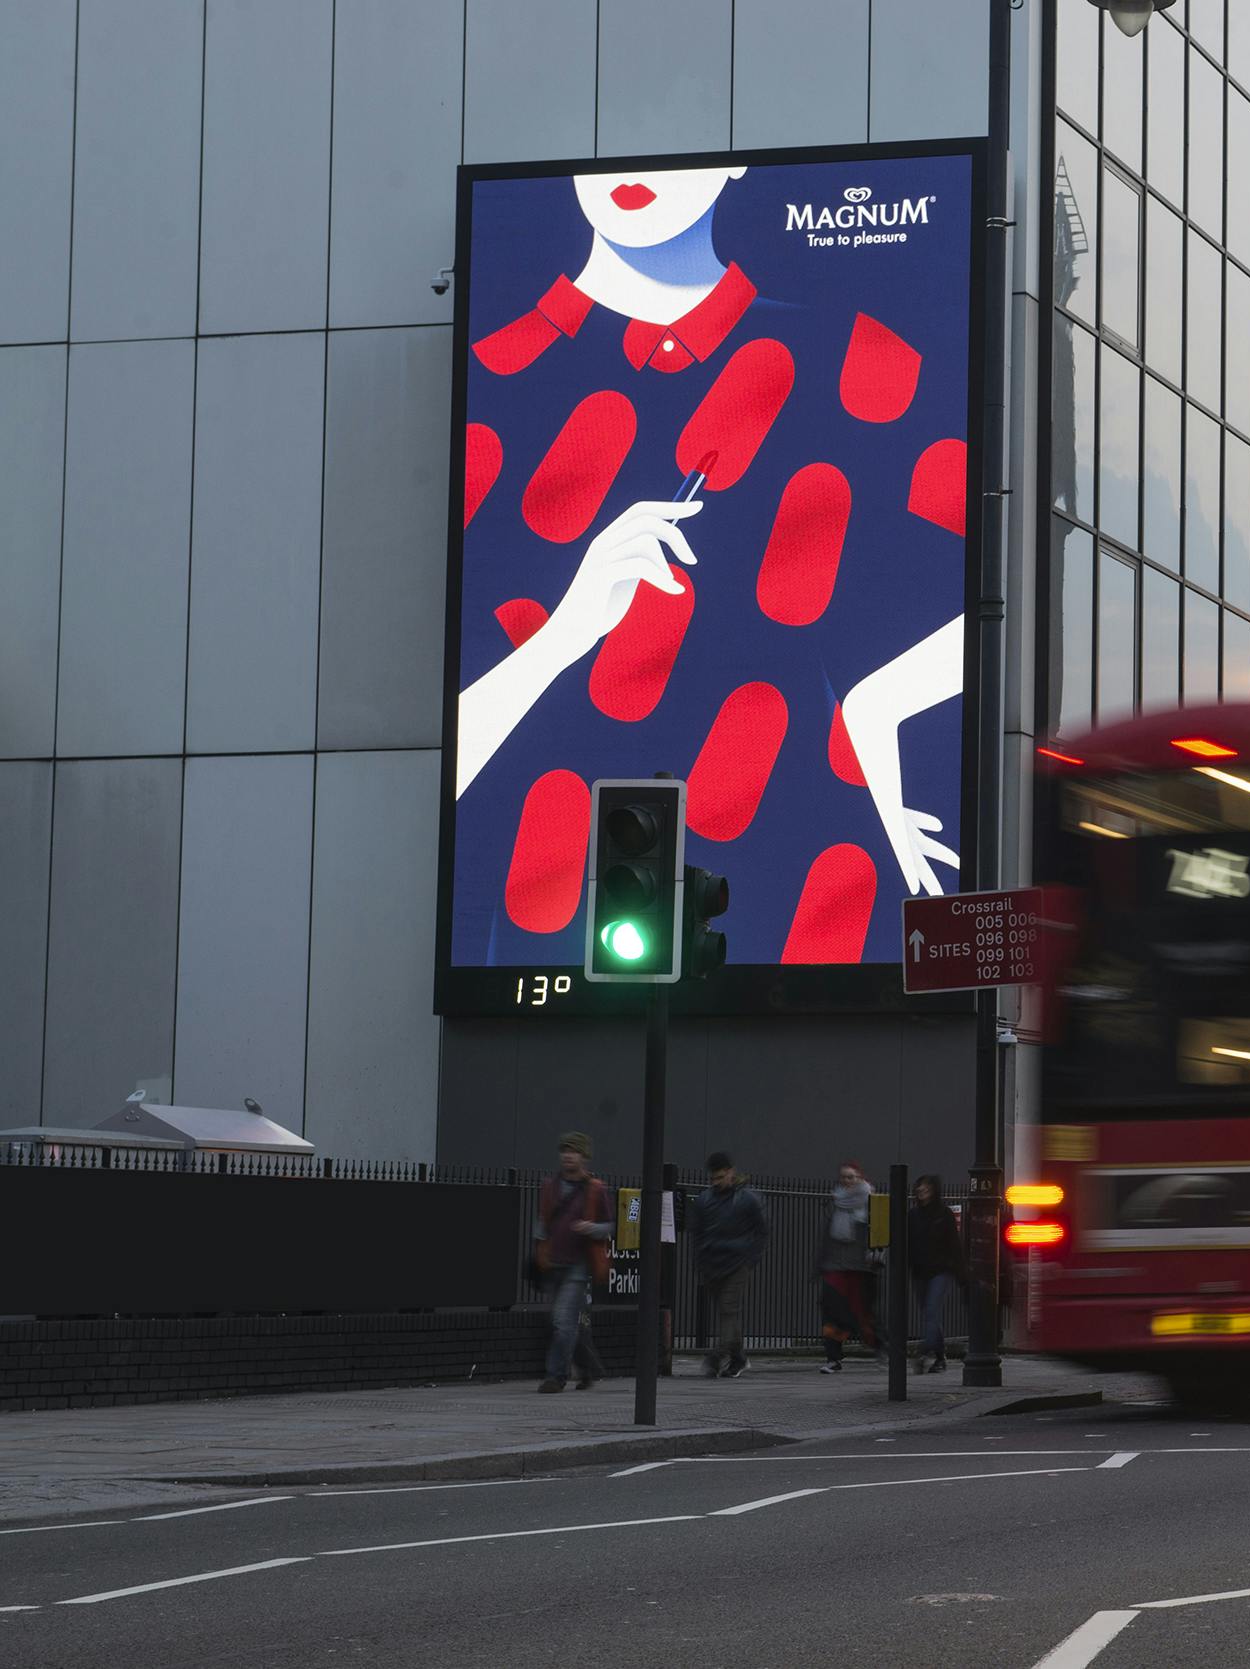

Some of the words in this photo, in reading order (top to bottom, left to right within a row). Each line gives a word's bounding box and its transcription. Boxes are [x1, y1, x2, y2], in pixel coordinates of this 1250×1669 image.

[785, 196, 929, 231] MAGNUM
[807, 234, 834, 247] True
[838, 234, 850, 245] to
[854, 231, 907, 248] pleasure
[952, 897, 1014, 915] Crossrail
[975, 915, 1004, 929] 005
[1008, 912, 1037, 927] 006
[976, 931, 1004, 946] 096
[1008, 929, 1037, 943] 098
[929, 943, 971, 959] SITES
[976, 948, 1005, 963] 099
[1008, 946, 1031, 960] 101
[976, 965, 1001, 980] 102
[1009, 963, 1034, 977] 103
[608, 1268, 640, 1293] Parki
